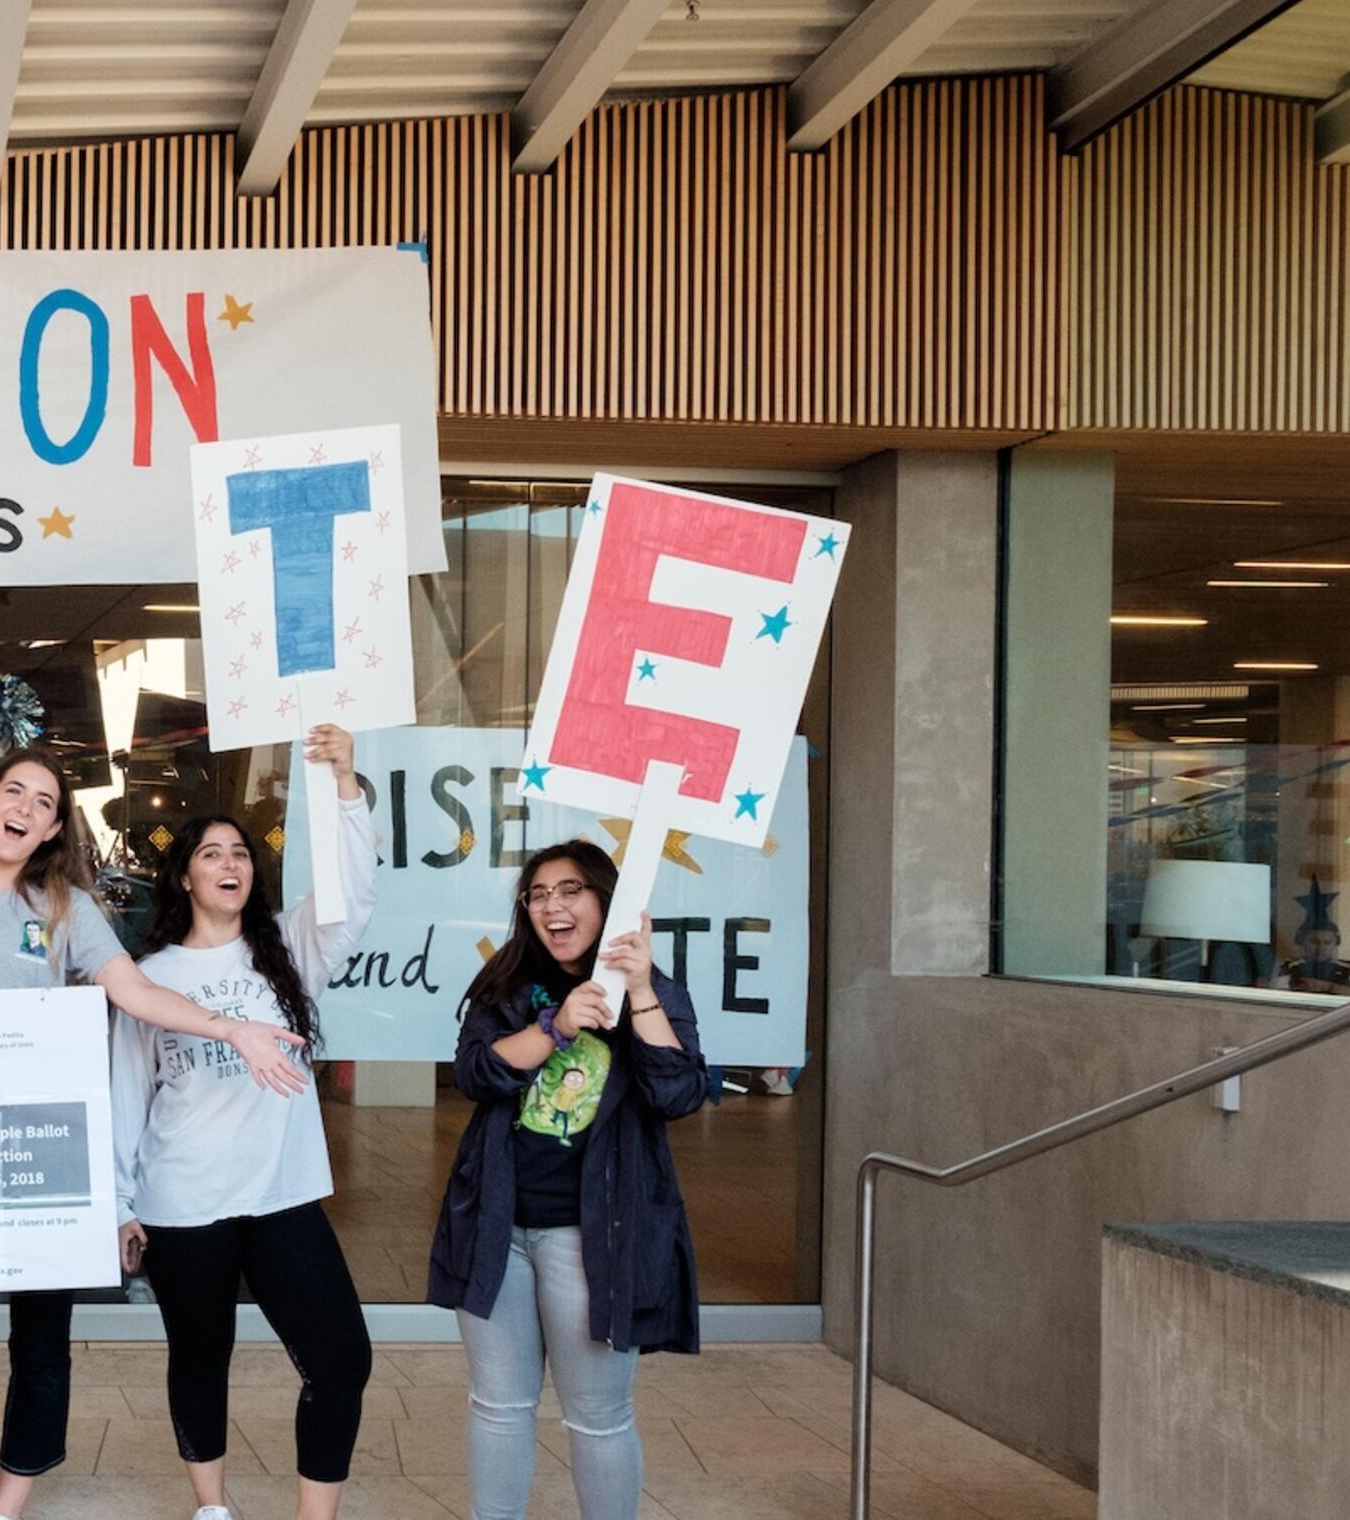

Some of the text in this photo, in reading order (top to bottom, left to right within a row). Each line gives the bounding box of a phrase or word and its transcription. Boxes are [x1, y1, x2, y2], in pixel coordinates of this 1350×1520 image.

[227, 461, 371, 677] T
[549, 483, 807, 803] E
[167, 1047, 196, 1080] SAN
[26, 1124, 70, 1139] Ballot
[10, 1172, 45, 1186] 2018
[17, 1218, 44, 1227] closes
[46, 1217, 55, 1226] at
[64, 1217, 77, 1227] pm
